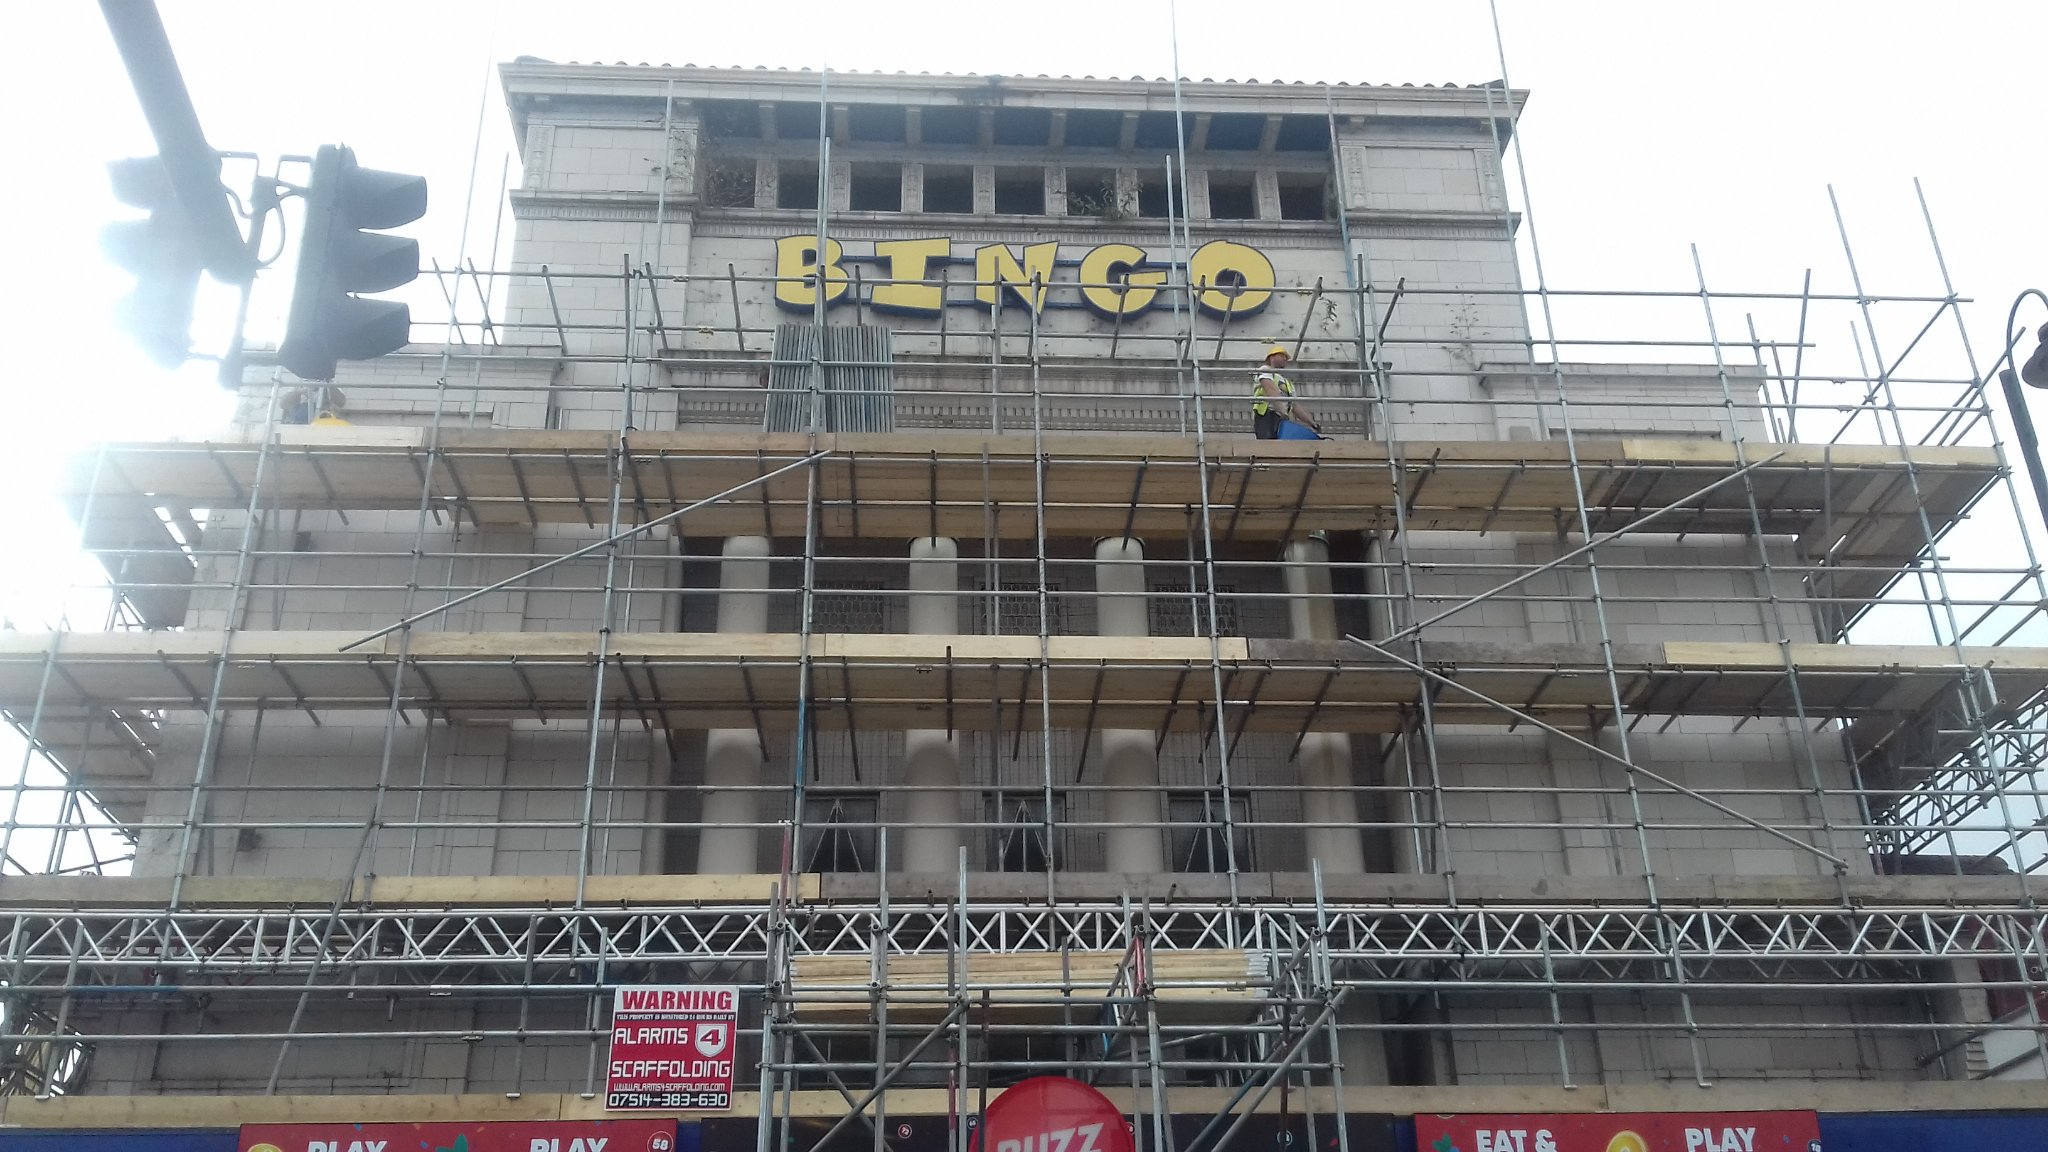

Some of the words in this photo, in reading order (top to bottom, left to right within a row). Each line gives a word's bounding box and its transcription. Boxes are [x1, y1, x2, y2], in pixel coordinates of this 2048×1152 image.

[775, 234, 1276, 320] BINGO
[622, 990, 732, 1011] WARNING
[614, 1028, 689, 1045] ALARMS
[700, 1029, 722, 1046] 4
[611, 1060, 731, 1078] SCAFFOLDING
[608, 1093, 728, 1107] 07514-383-630
[652, 1138, 669, 1150] 58
[1475, 1129, 1528, 1152] EAT
[1535, 1129, 1557, 1152] &
[1684, 1127, 1756, 1152] PLAY
